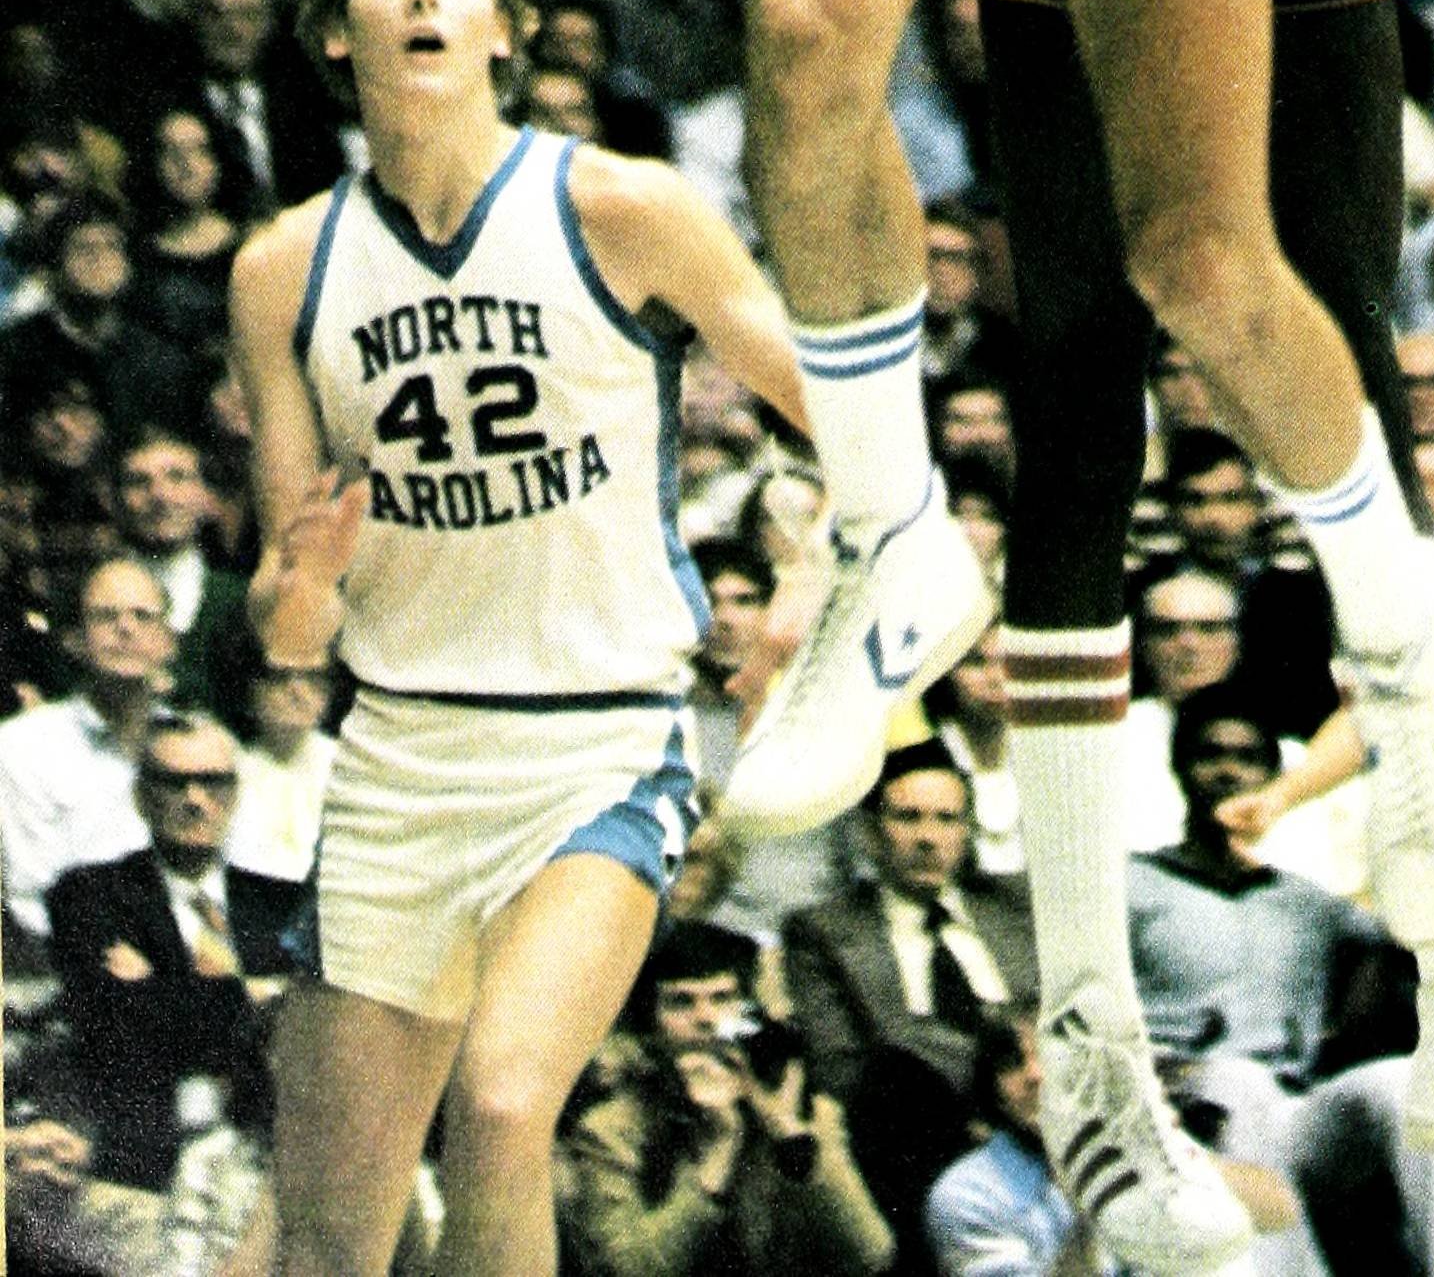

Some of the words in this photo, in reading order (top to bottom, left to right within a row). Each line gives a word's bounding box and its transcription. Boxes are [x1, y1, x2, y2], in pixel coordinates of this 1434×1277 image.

[351, 295, 549, 384] NORTH
[375, 364, 547, 464] 42
[366, 432, 612, 531] AROLINA
